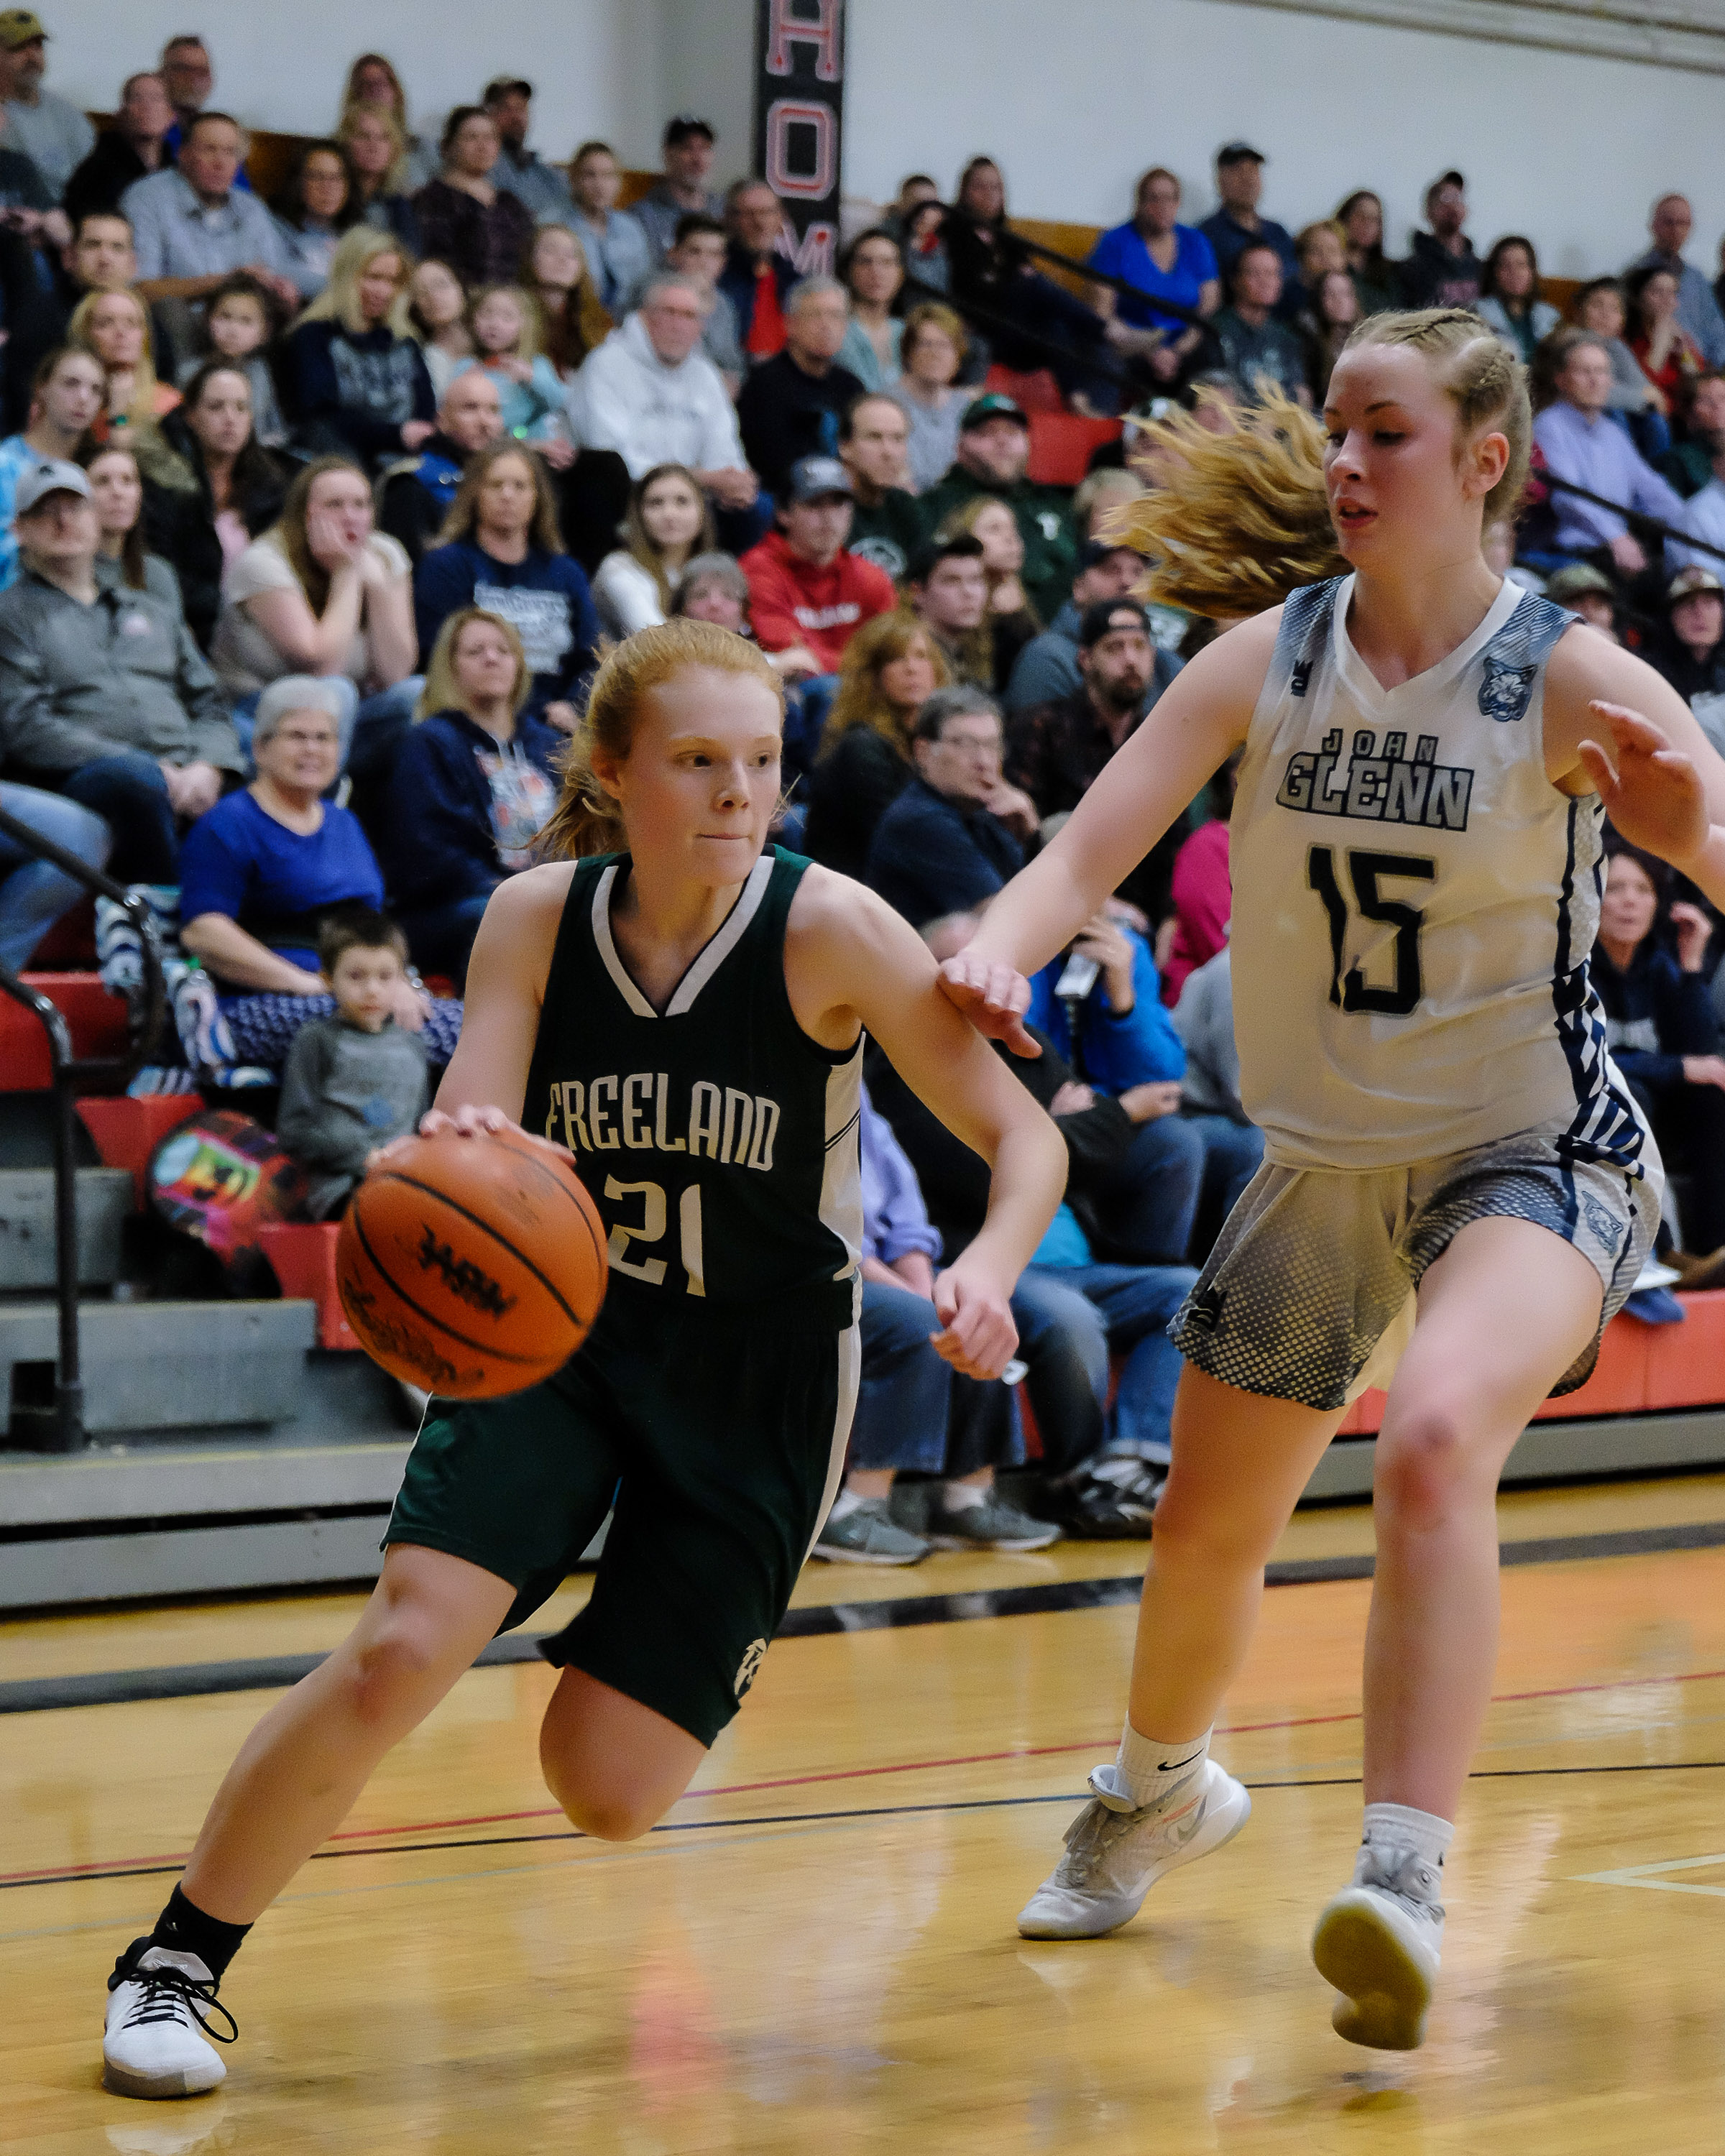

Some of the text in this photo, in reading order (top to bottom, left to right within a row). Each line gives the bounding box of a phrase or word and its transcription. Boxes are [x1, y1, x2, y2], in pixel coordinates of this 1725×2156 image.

[1276, 751, 1475, 832] GLENN
[1321, 728, 1439, 764] JOHN
[1305, 842, 1438, 1020] 15
[546, 1073, 781, 1172] FREELAND
[604, 1174, 707, 1298] 21
